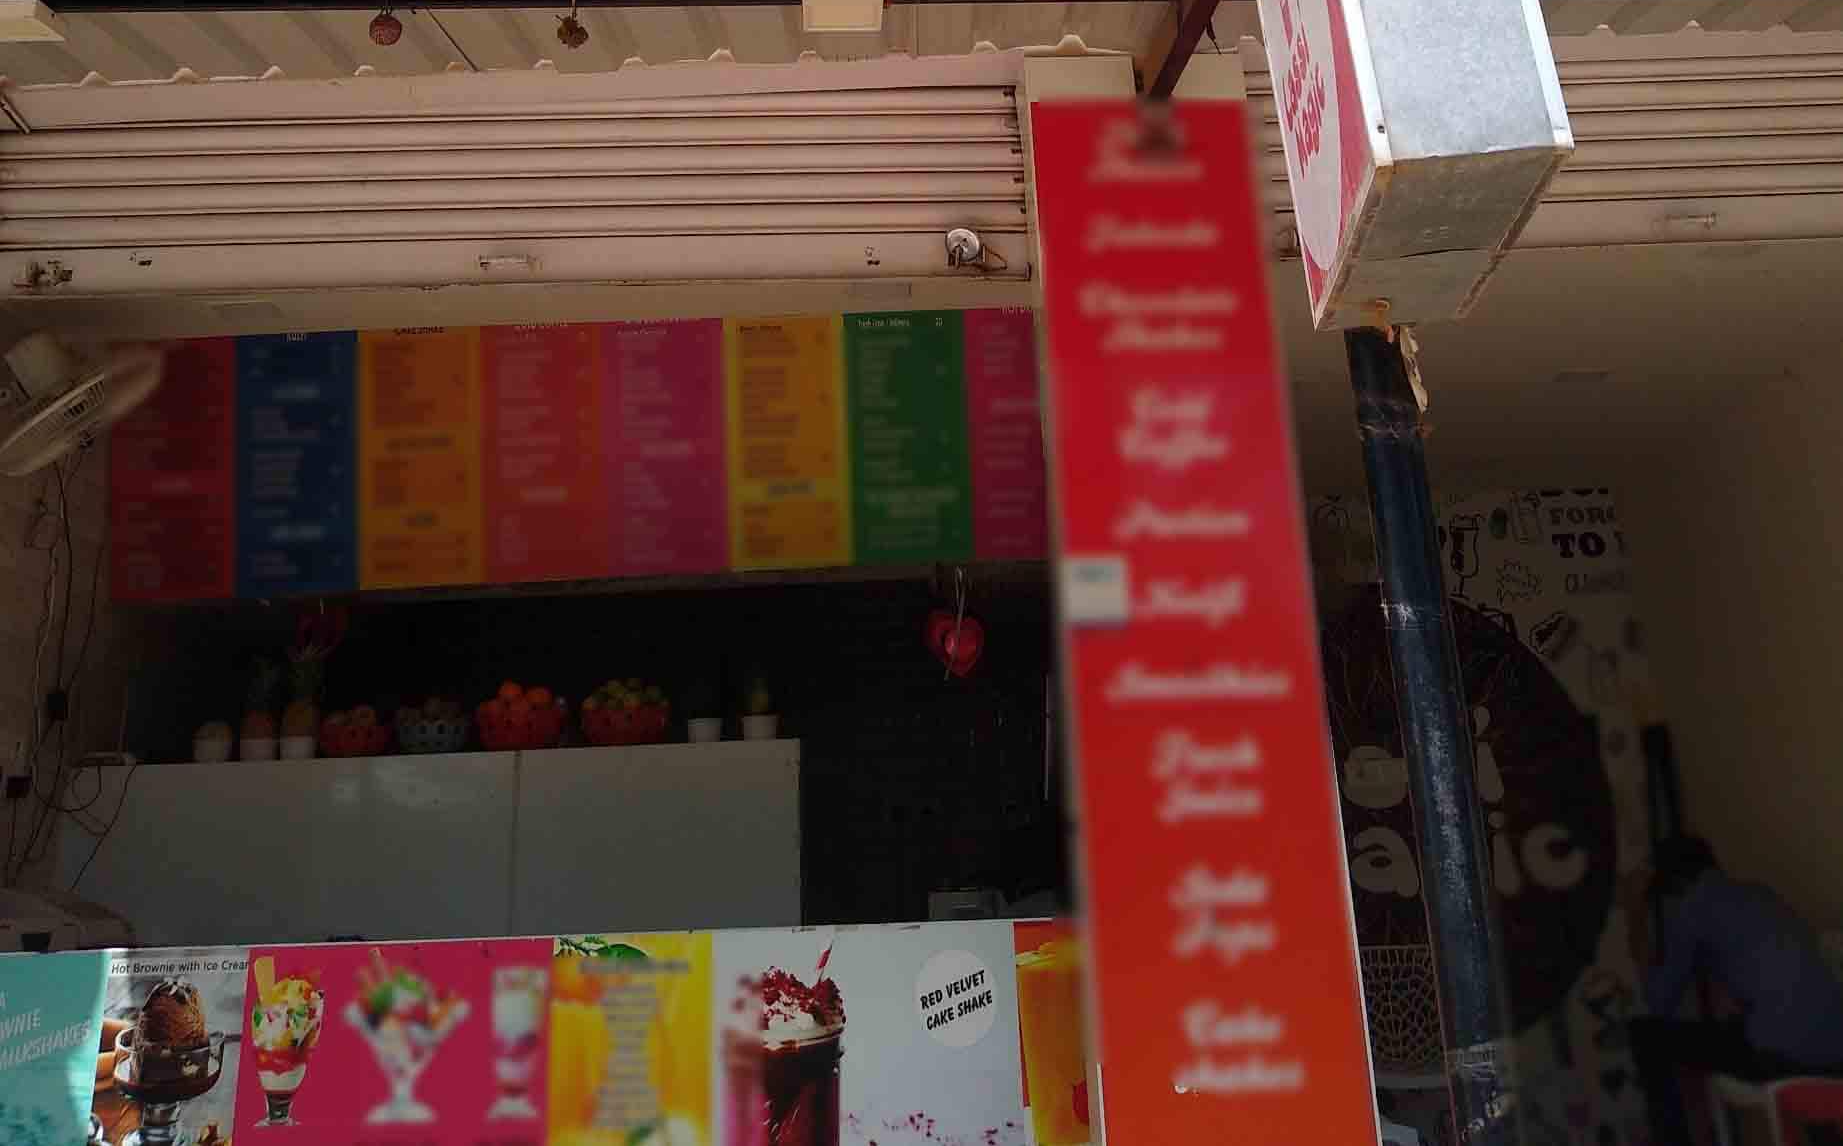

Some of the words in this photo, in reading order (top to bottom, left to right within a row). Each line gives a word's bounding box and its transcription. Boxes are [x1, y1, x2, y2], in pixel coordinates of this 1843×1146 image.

[1295, 61, 1326, 181] Magic
[111, 962, 130, 975] Hot
[133, 960, 176, 975] Brownie
[178, 959, 200, 973] with
[203, 960, 218, 972] Ice
[920, 989, 943, 1010] RED
[945, 969, 985, 998] VELVET
[926, 1007, 954, 1031] CAKE
[957, 990, 993, 1017] SHAKE
